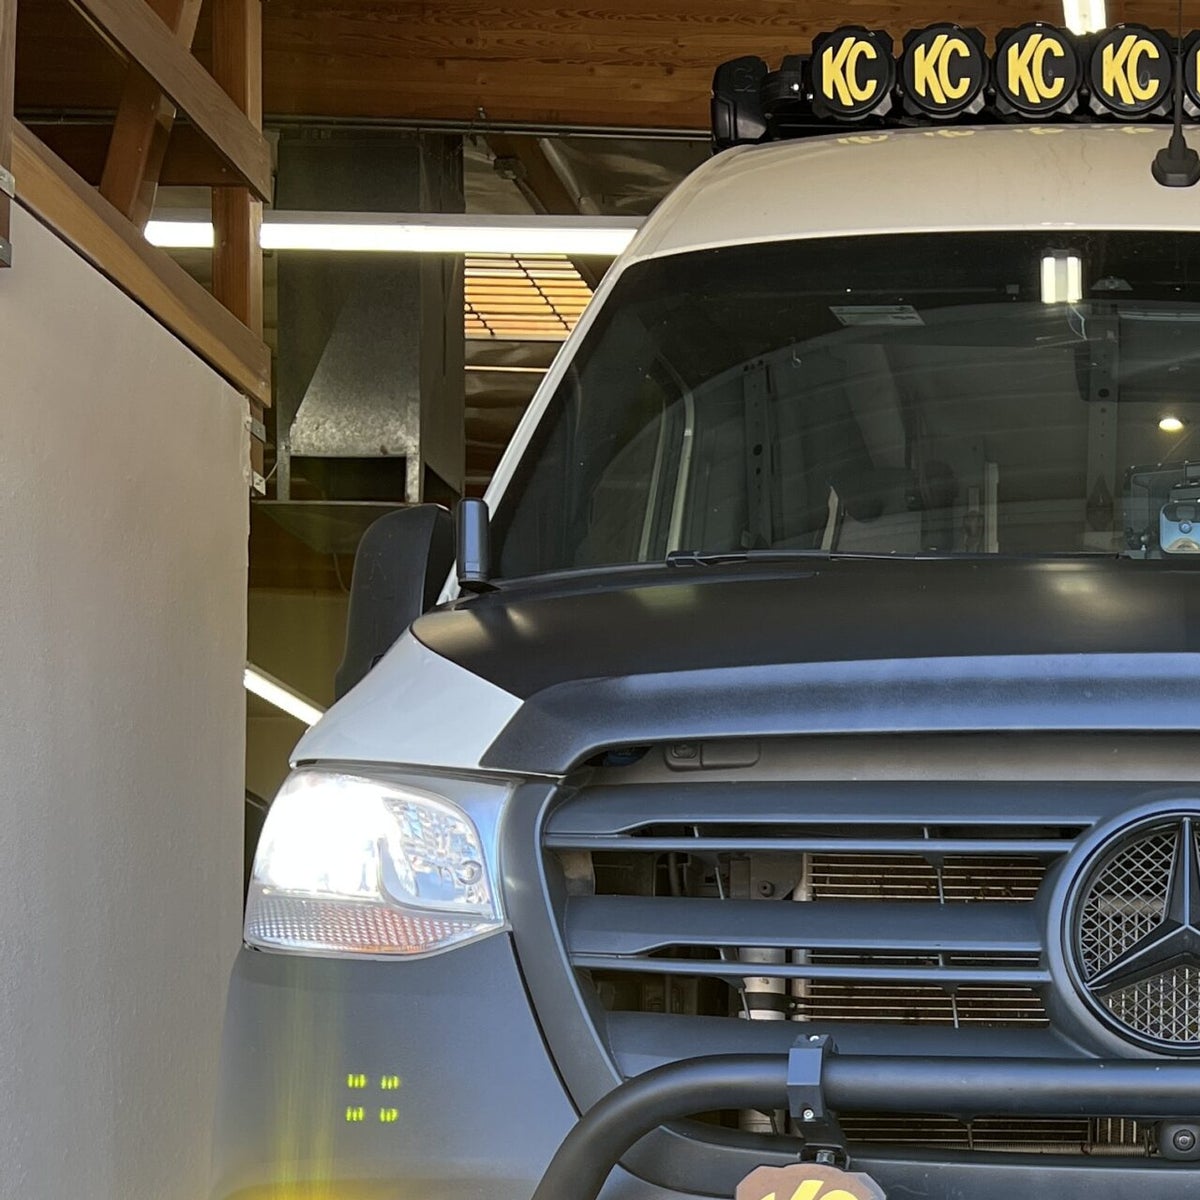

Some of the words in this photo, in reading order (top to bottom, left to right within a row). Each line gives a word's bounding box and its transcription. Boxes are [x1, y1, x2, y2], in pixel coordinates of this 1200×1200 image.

[823, 37, 877, 106] KC
[915, 35, 970, 104] KC
[1007, 34, 1064, 104] KC
[1103, 35, 1159, 105] KC
